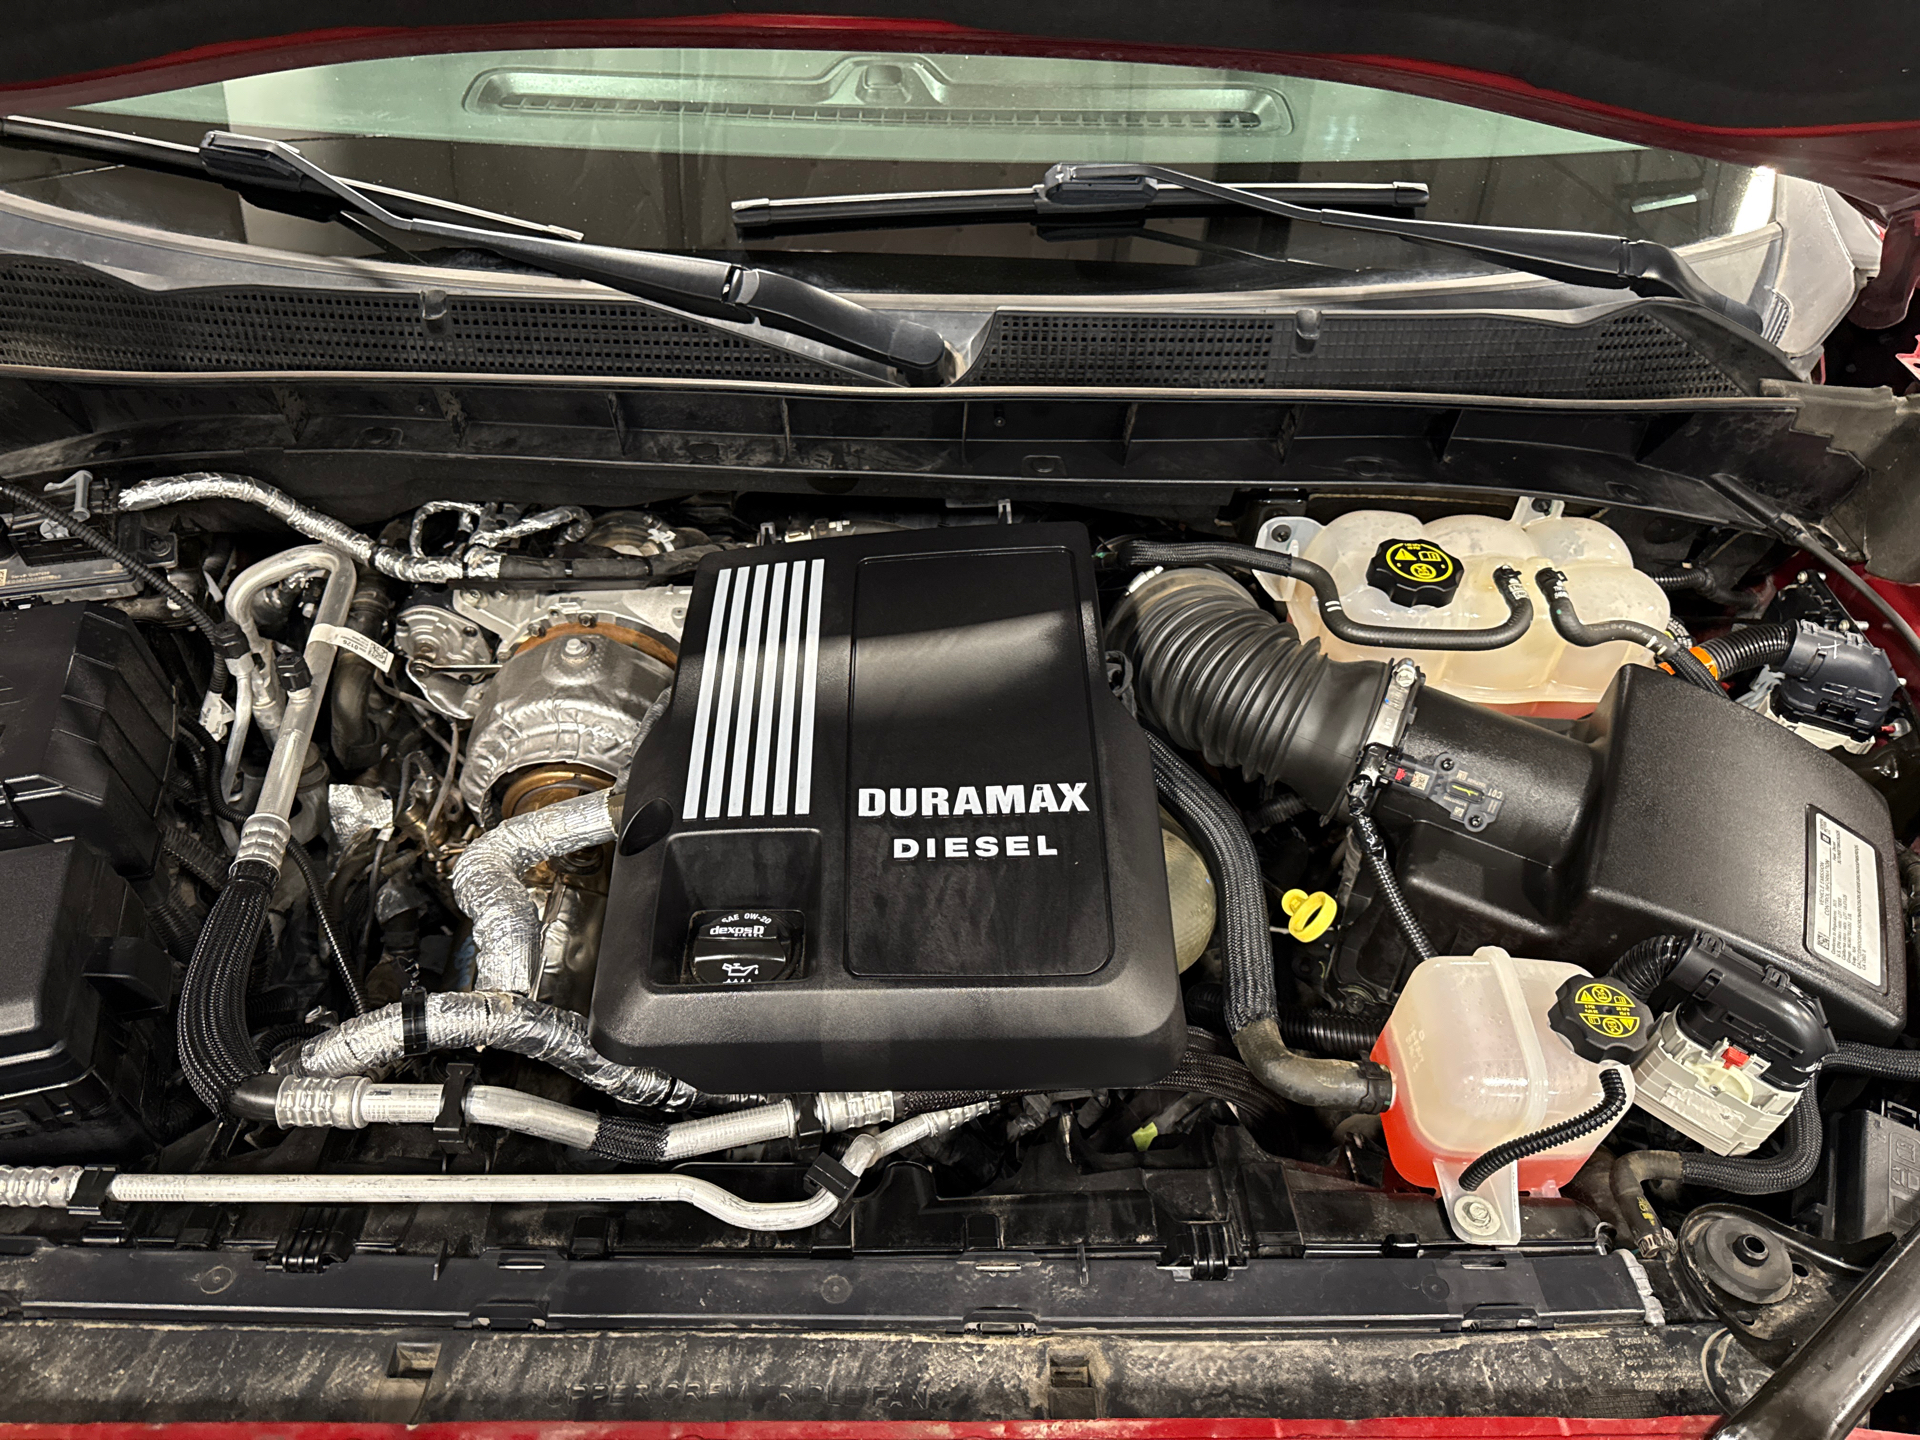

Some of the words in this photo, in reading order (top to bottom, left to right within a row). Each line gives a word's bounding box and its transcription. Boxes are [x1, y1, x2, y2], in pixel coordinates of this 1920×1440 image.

[858, 782, 1090, 817] DURAMAX
[893, 835, 1058, 859] DIESEL
[721, 913, 740, 923] SAE
[744, 912, 772, 924] 0W-20
[546, 1381, 650, 1408] UPPER
[872, 1382, 930, 1410] FAN
